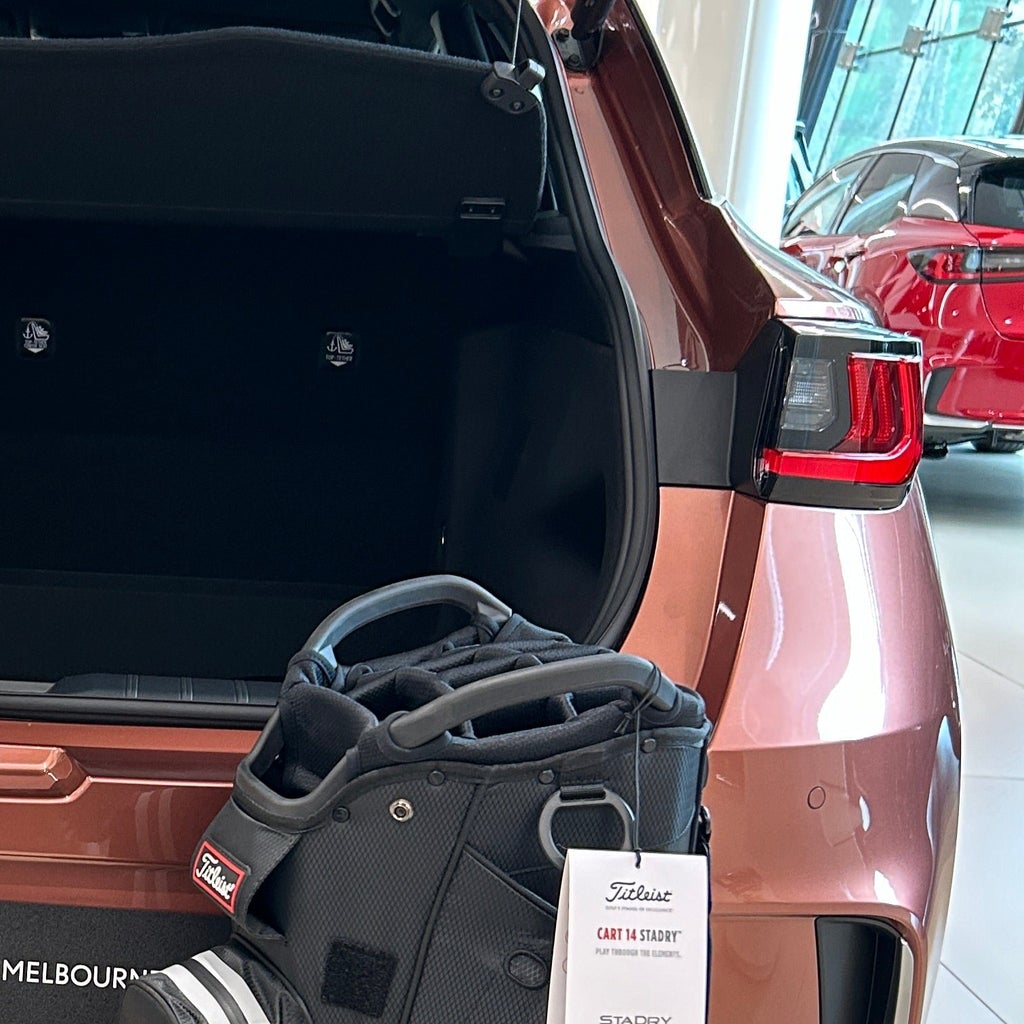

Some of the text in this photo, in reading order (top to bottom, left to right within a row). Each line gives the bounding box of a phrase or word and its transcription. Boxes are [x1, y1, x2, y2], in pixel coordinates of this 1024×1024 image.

[605, 881, 673, 902] Titleist
[597, 927, 623, 941] CART
[625, 928, 637, 941] 14
[2, 959, 162, 990] MELBOUR
